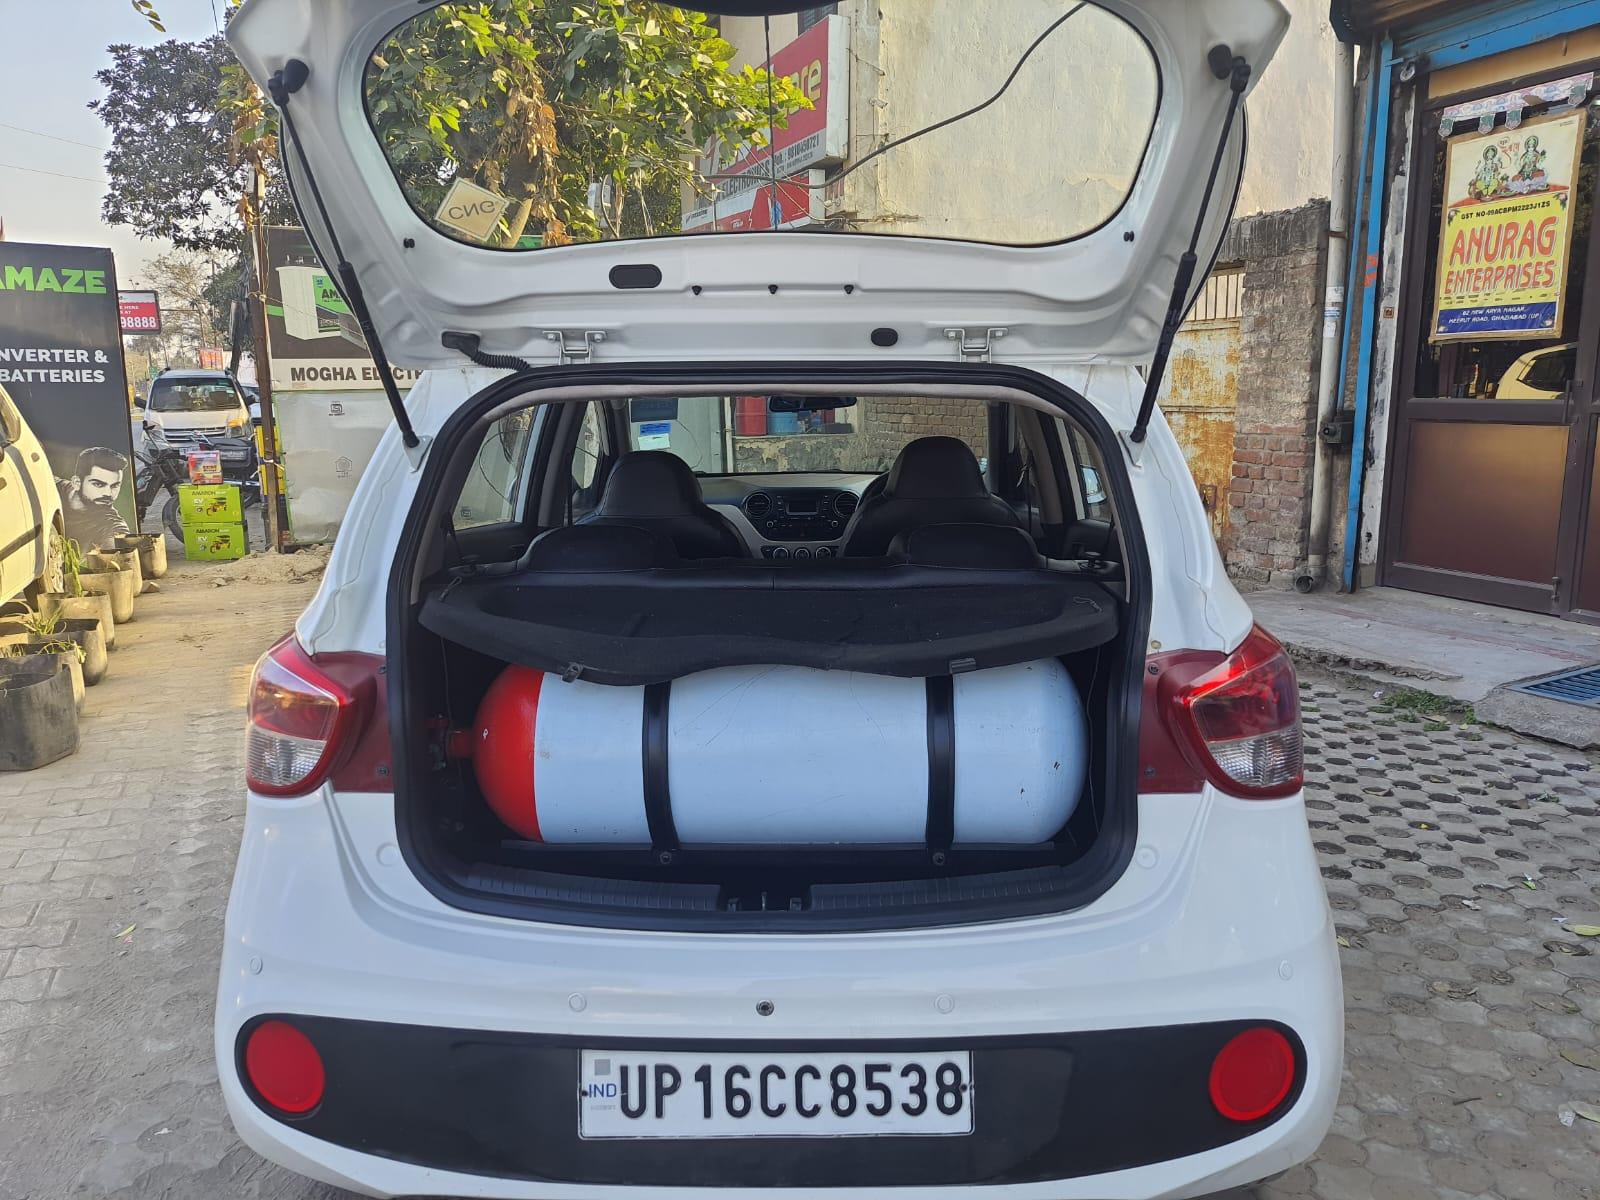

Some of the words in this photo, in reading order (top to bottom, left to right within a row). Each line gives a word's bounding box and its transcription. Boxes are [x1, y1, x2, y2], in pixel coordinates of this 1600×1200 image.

[1448, 215, 1558, 267] ANURAG
[0, 265, 107, 294] MAZE
[1444, 260, 1556, 295] ENTERPRISES
[94, 349, 110, 363] &
[0, 368, 106, 383] BATTERIES
[290, 366, 358, 382] MOGHA
[588, 1083, 617, 1098] IND
[620, 1062, 964, 1119] UP16CC8538
